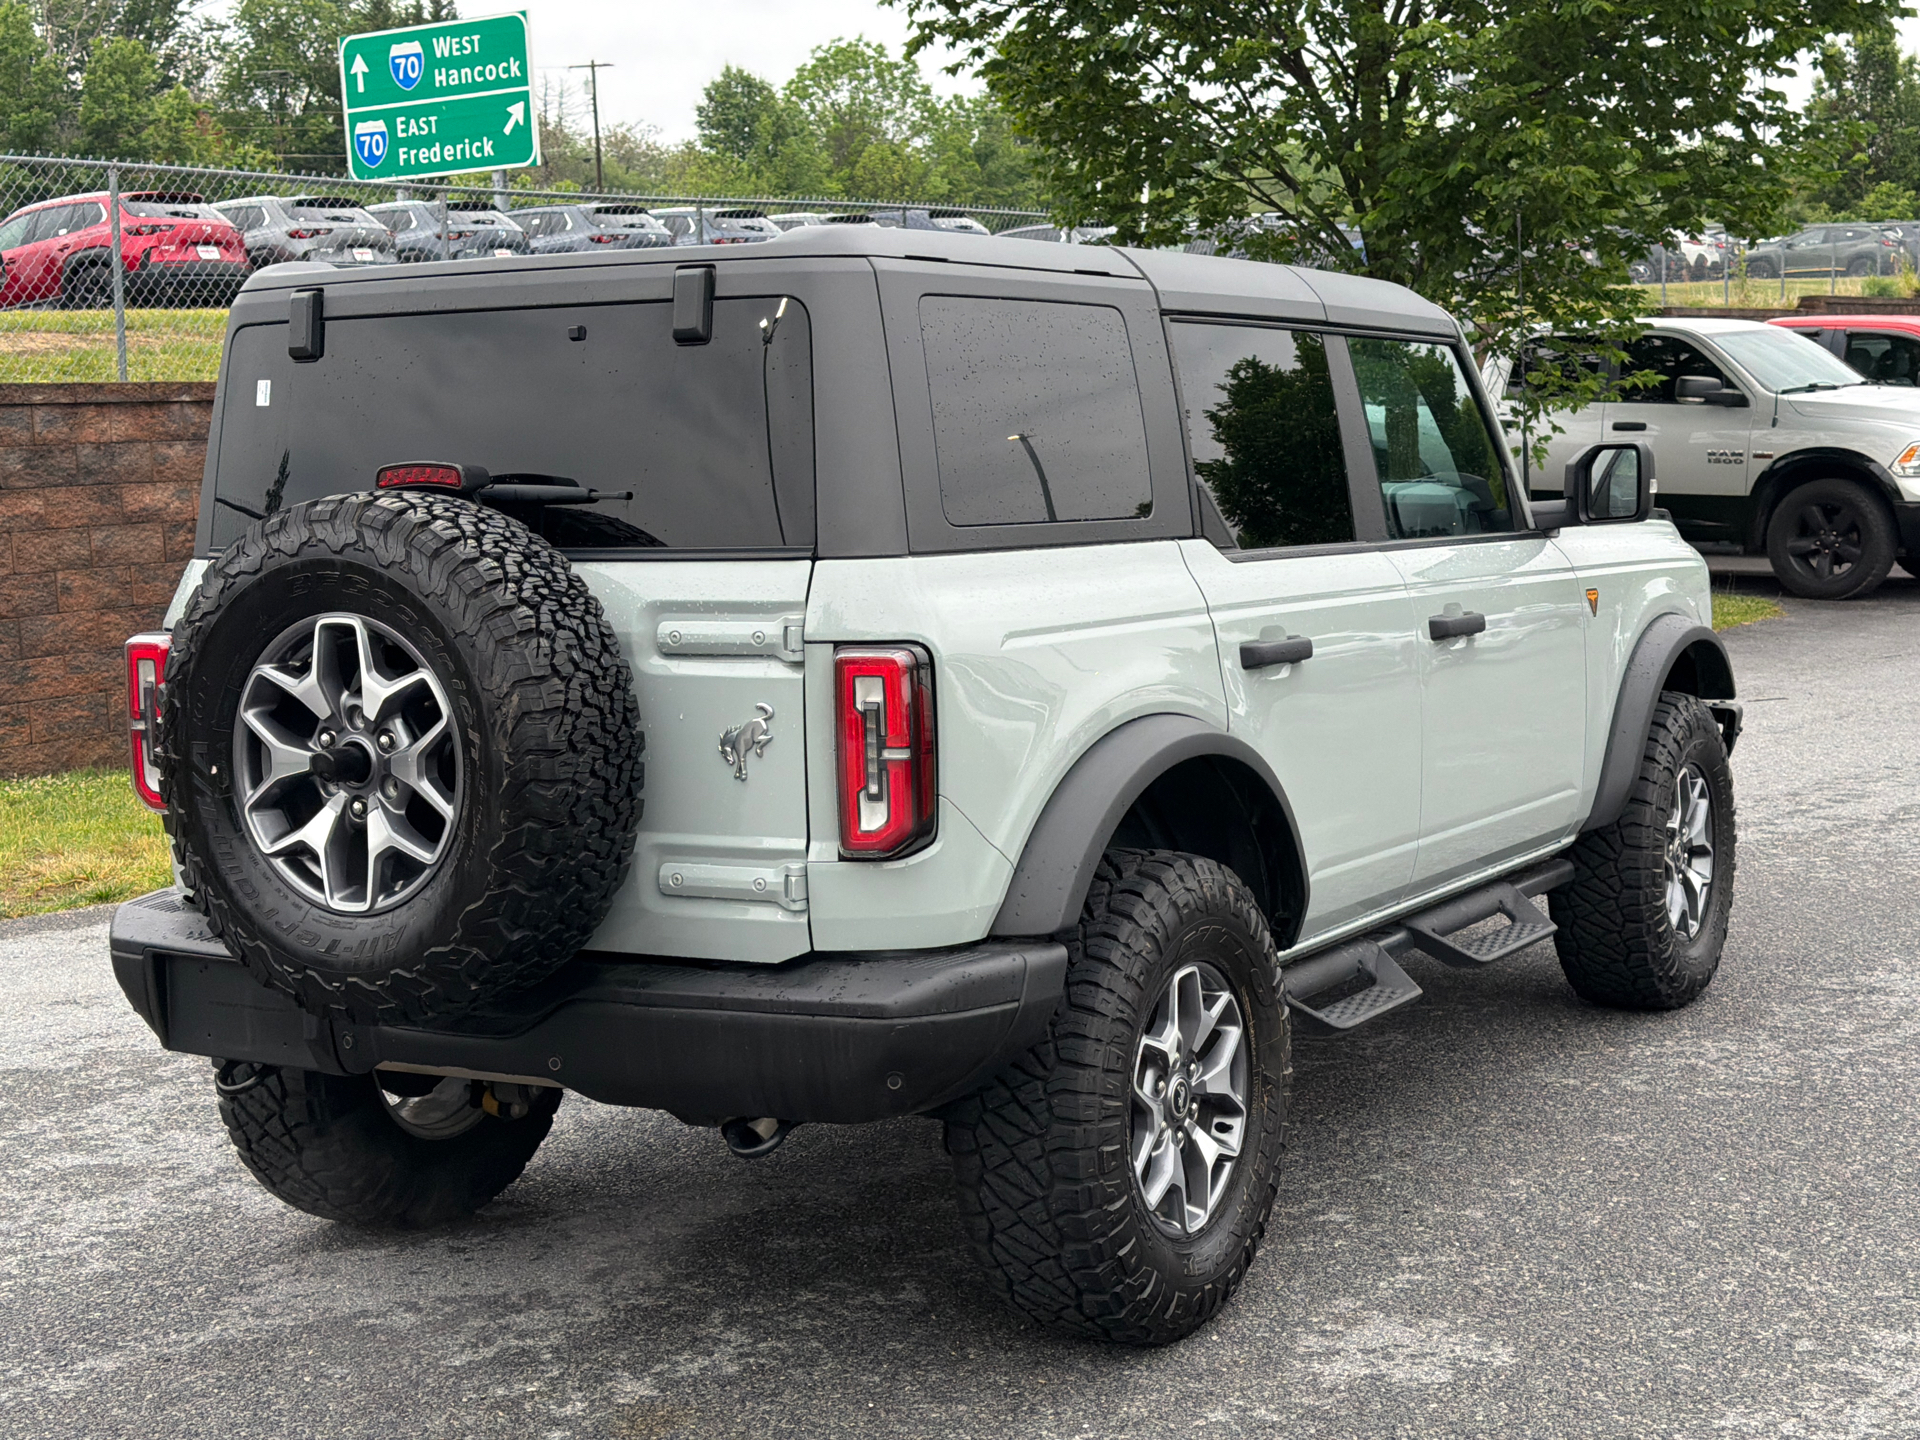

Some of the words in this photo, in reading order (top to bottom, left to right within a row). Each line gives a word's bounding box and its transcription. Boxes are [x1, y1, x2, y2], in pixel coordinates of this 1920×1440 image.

[432, 35, 481, 58] WEST
[394, 56, 419, 80] 70
[434, 56, 521, 87] Hancock
[396, 116, 438, 138] EAST
[359, 134, 384, 158] 70
[398, 136, 495, 166] Frederick
[1707, 449, 1744, 457] RAM
